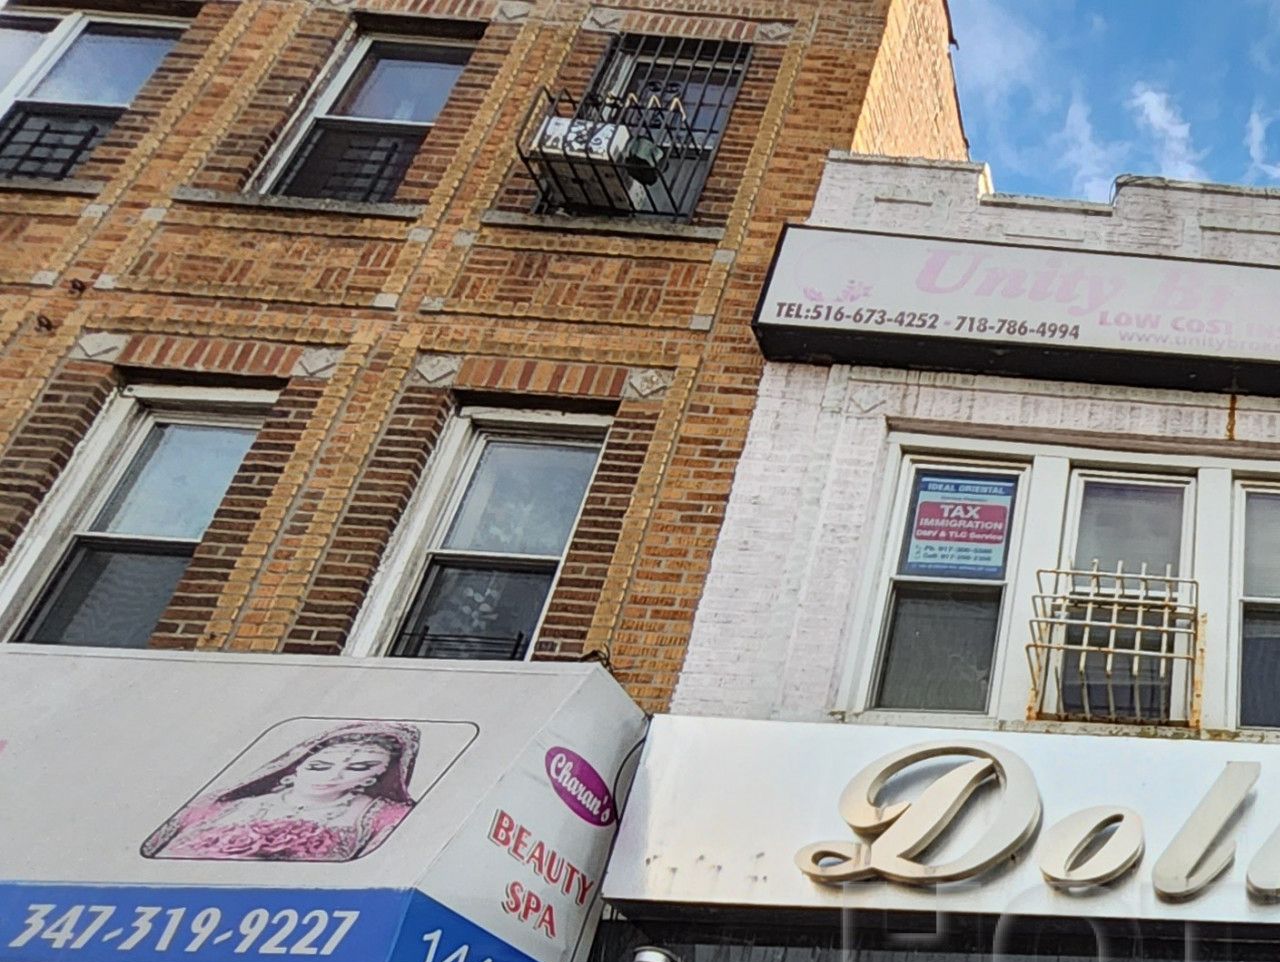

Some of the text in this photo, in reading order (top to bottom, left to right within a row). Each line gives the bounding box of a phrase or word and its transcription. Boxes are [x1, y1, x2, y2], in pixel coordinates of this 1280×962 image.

[953, 316, 1080, 341] 718-786-4994
[1098, 310, 1161, 330] LOW
[1171, 315, 1233, 336] COST
[927, 482, 957, 492] IDEAL
[919, 518, 1004, 531] IMMIGRATION
[940, 504, 982, 519] TAX
[550, 753, 611, 823] Charan's
[488, 808, 595, 906] BEAUTY
[501, 881, 558, 940] SPA
[9, 903, 360, 956] 347-319-9227
